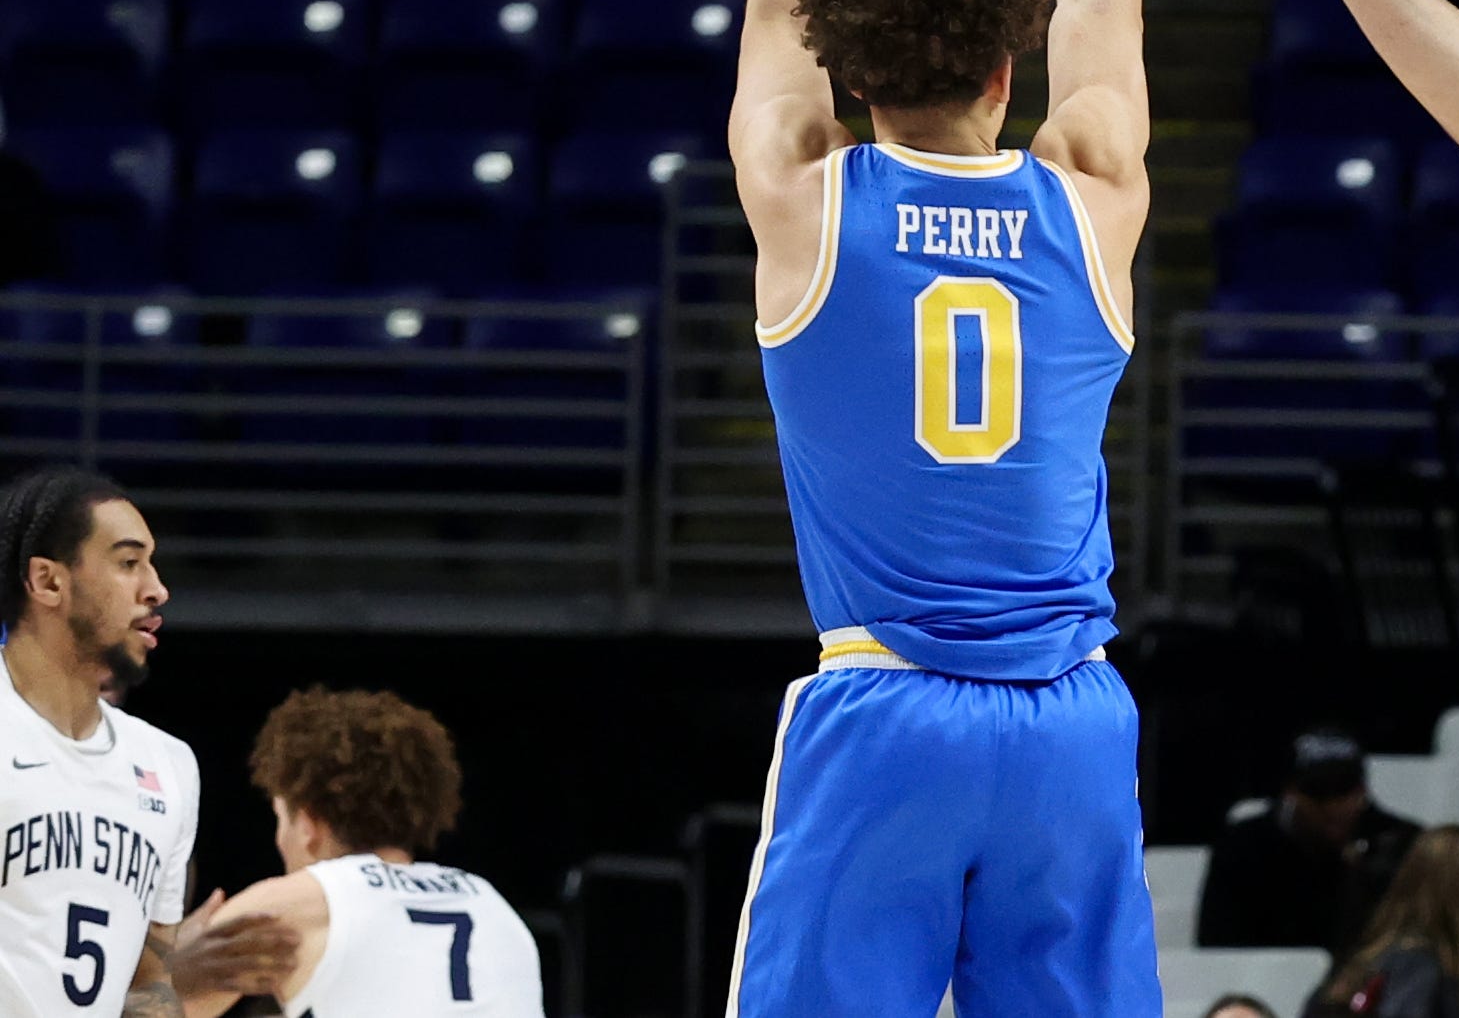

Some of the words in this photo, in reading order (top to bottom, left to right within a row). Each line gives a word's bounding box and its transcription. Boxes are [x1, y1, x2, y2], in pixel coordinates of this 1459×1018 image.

[895, 203, 1029, 258] PERRY
[914, 276, 1021, 464] 0
[1, 811, 82, 888] PENN
[93, 815, 161, 920] STATE
[62, 902, 109, 1007] 5
[406, 907, 474, 1002] 7
